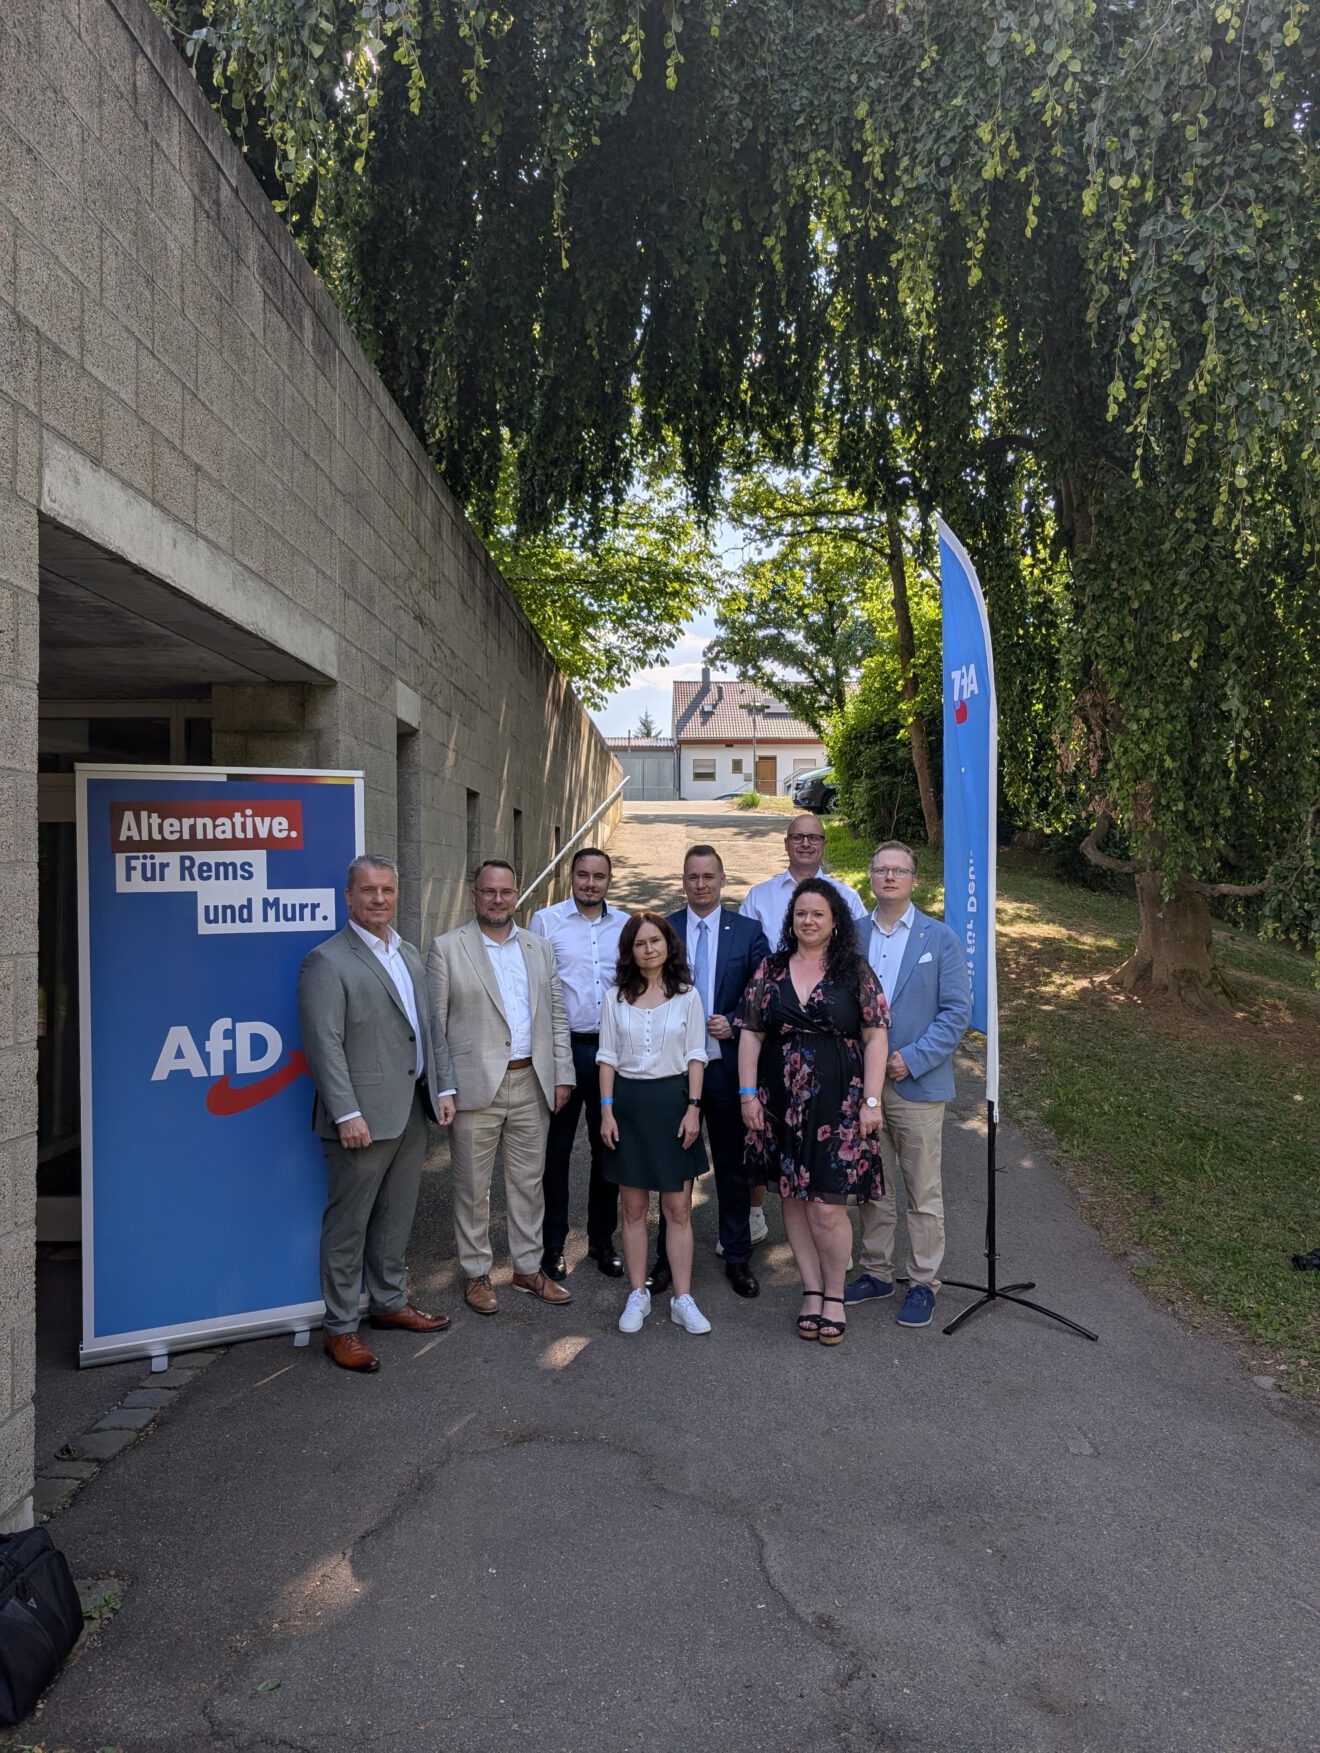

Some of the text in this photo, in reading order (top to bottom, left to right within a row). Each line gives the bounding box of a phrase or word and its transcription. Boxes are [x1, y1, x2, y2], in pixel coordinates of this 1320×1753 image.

[119, 808, 298, 841] Alternative.
[124, 854, 254, 882] Für Rems
[204, 897, 329, 924] und Murr.
[151, 1017, 283, 1081] AfD
